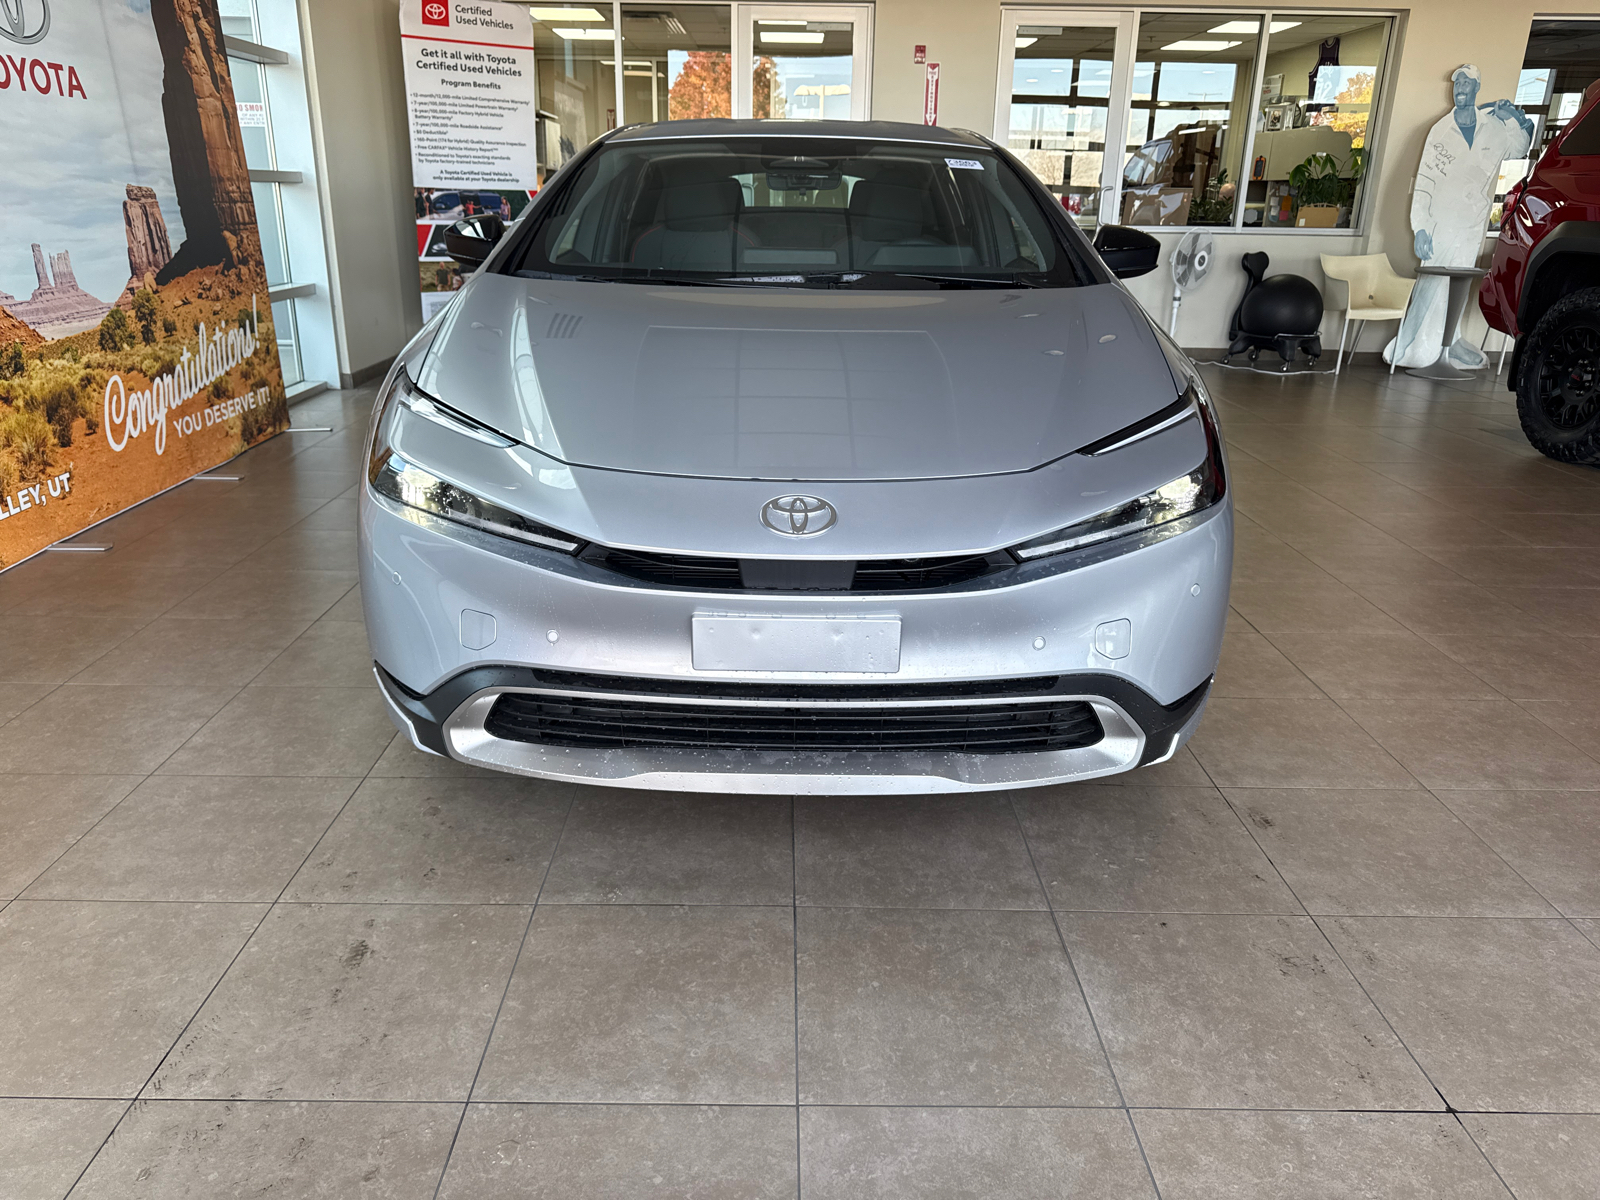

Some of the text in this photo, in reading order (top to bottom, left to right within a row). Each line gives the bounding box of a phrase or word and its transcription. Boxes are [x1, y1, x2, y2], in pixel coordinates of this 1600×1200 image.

[455, 4, 492, 16] Certified
[456, 16, 514, 29] Used Vehicles
[421, 48, 516, 65] Get it all with Toyota
[416, 60, 522, 76] Certified Used Vehicles
[441, 79, 501, 90] Program Benefits
[104, 293, 260, 455] Congratulations!
[173, 386, 270, 438] YOU DESERVE IT!
[0, 472, 70, 520] LLEY, UT
